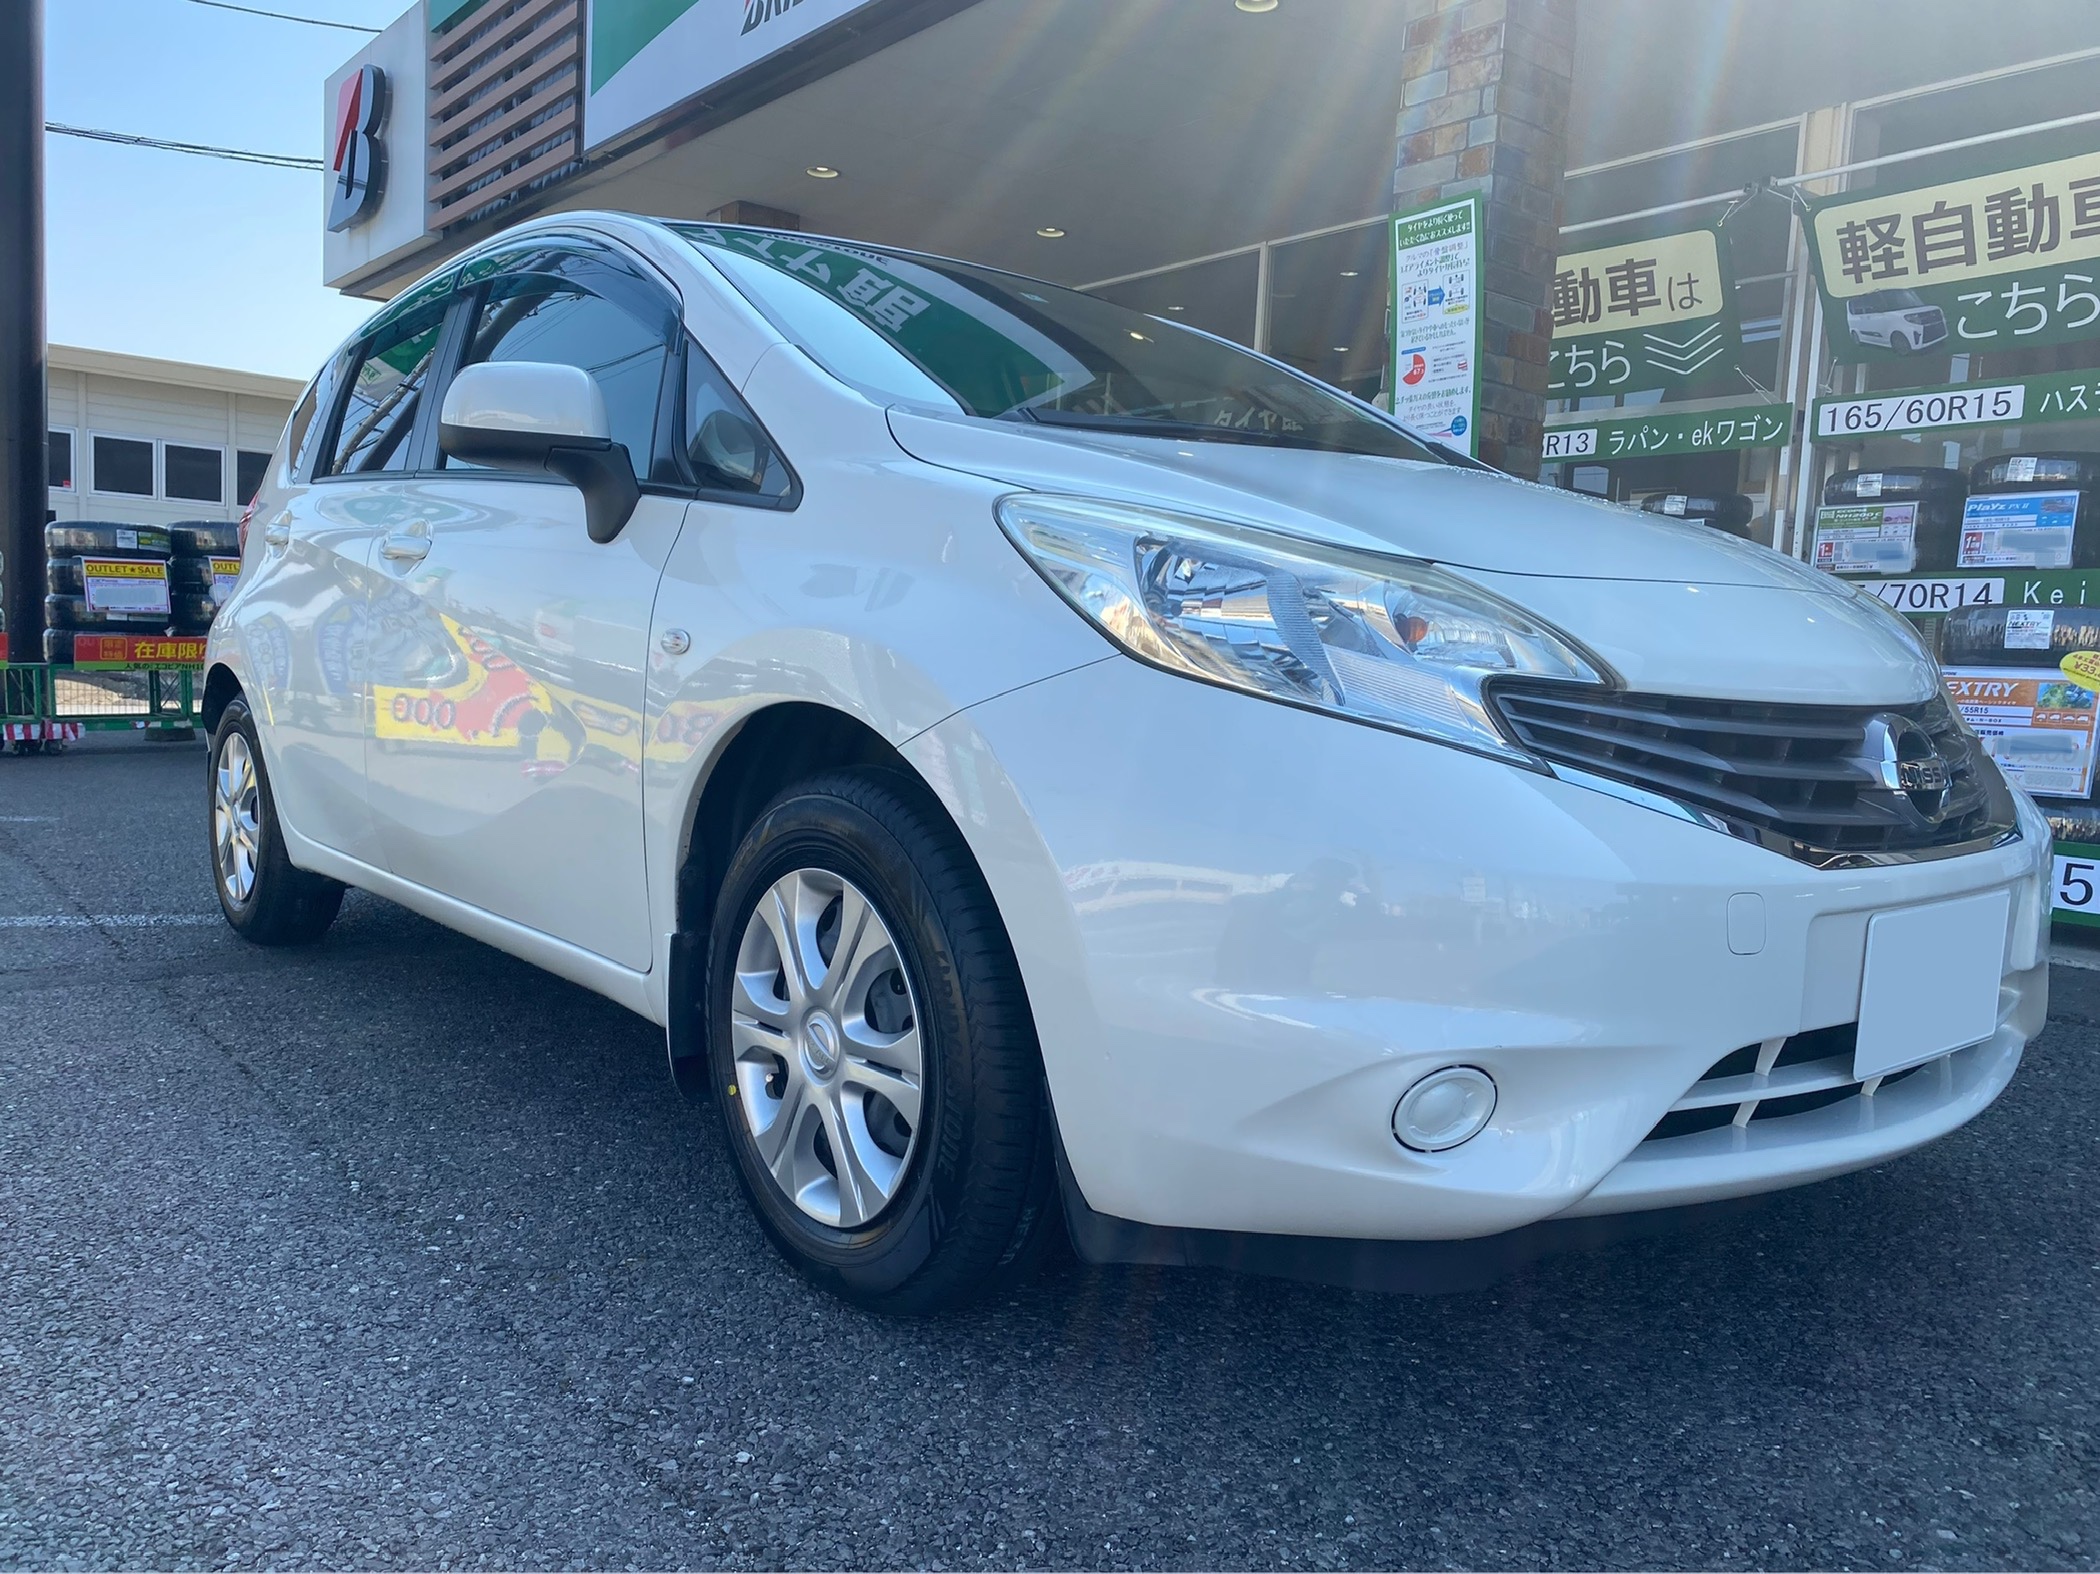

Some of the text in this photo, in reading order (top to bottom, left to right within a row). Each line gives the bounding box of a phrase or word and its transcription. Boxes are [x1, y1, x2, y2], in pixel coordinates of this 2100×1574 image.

[1552, 258, 1703, 327] 動車は
[1957, 273, 2100, 339] こちら
[1827, 383, 2100, 432] 165/60R15 ハス
[1543, 414, 1783, 456] R13 ラパン・ekワゴン
[86, 564, 128, 573] OUTLET
[1857, 583, 1992, 611] /70R14
